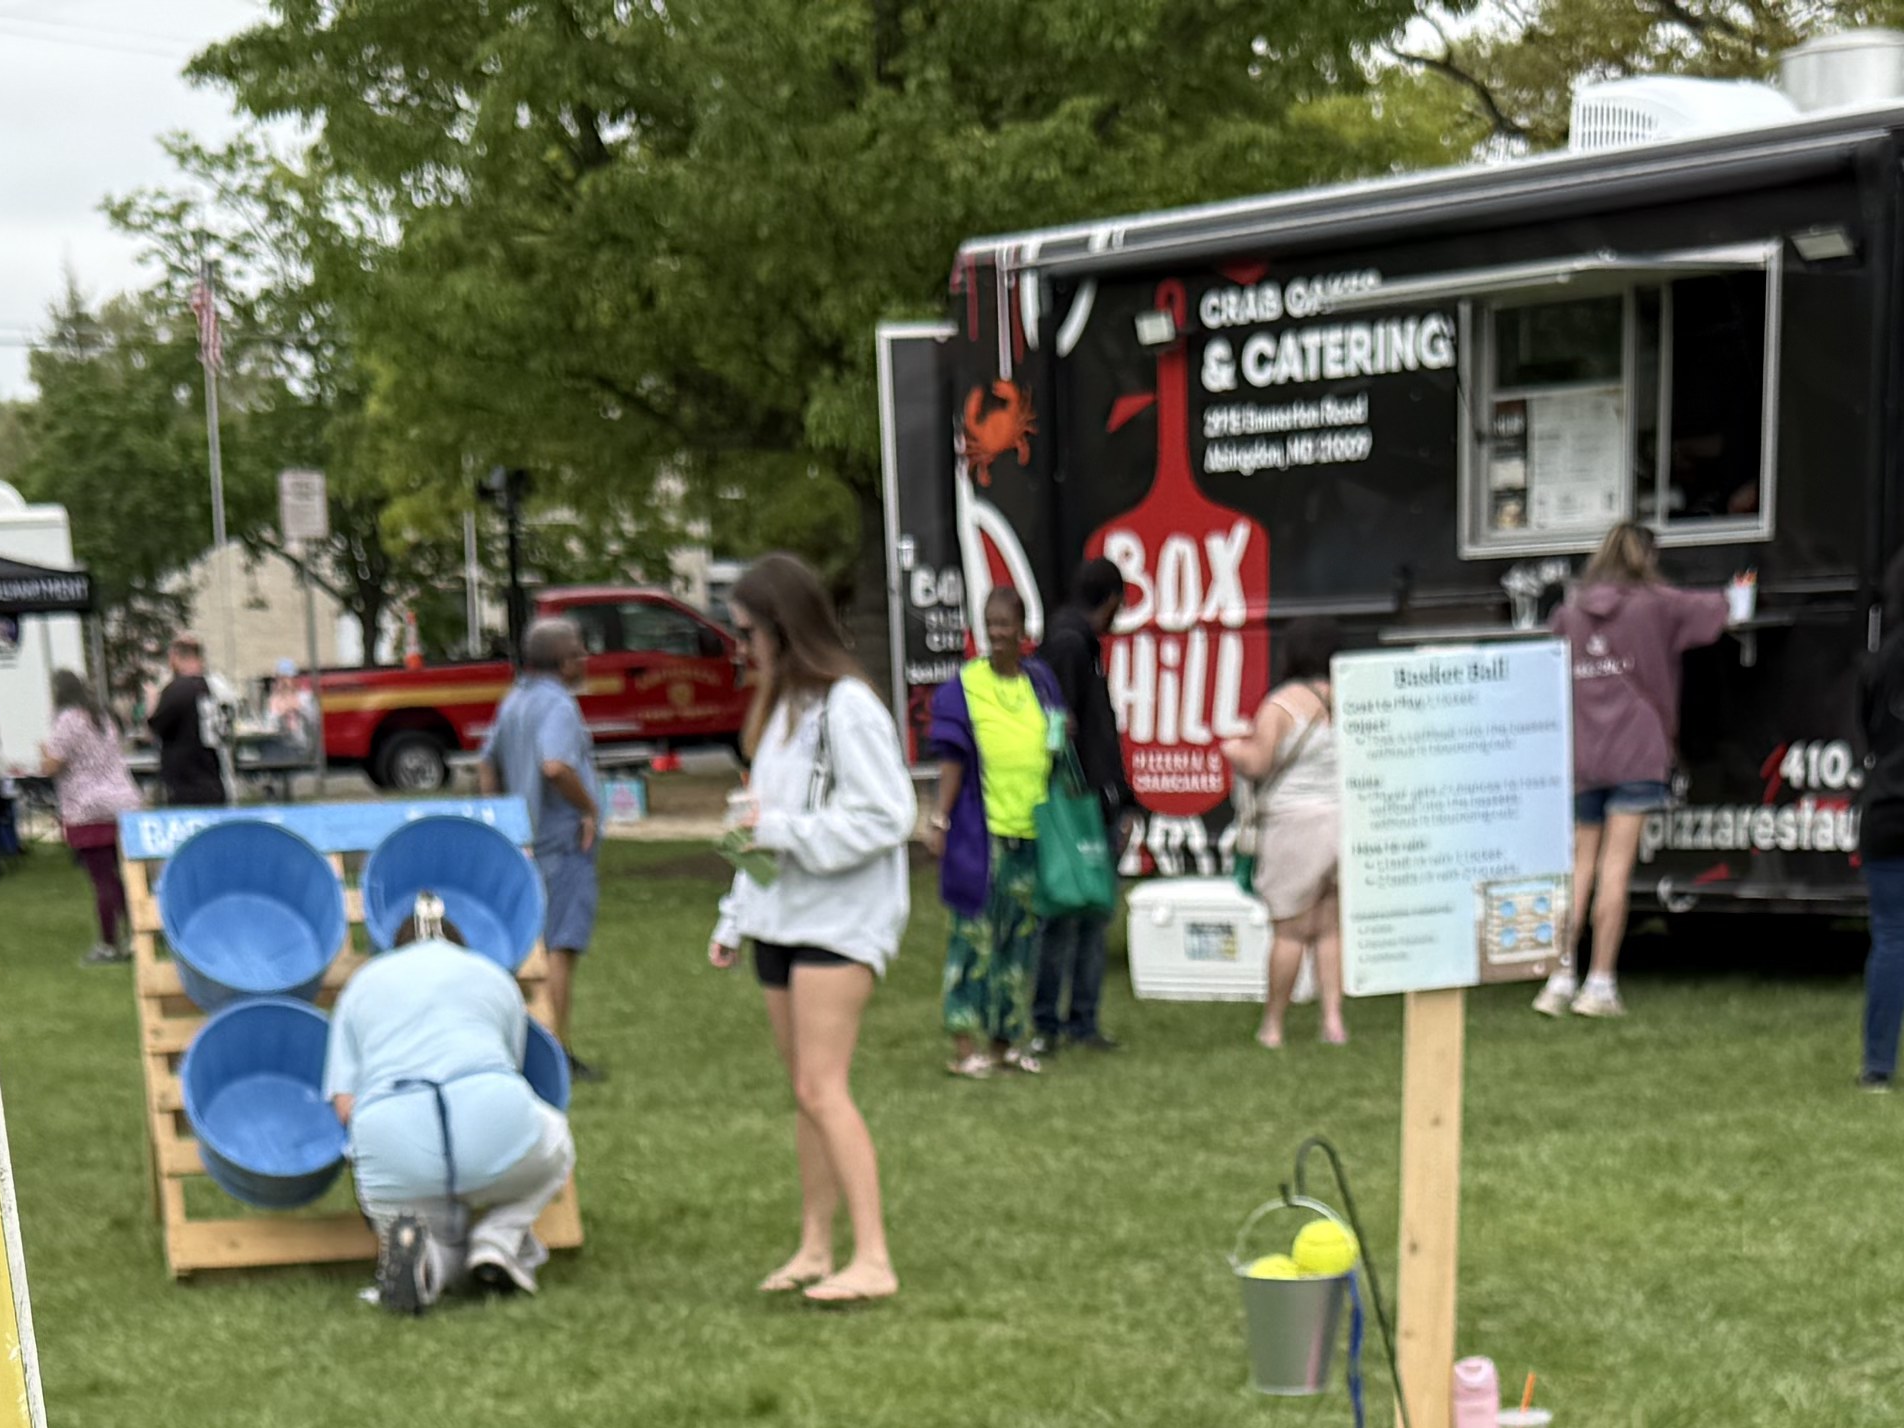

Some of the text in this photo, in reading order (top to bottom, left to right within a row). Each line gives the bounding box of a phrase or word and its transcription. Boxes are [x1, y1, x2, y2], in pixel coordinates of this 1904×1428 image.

[1201, 312, 1456, 393] & CATERING
[1104, 521, 1252, 635] BOX
